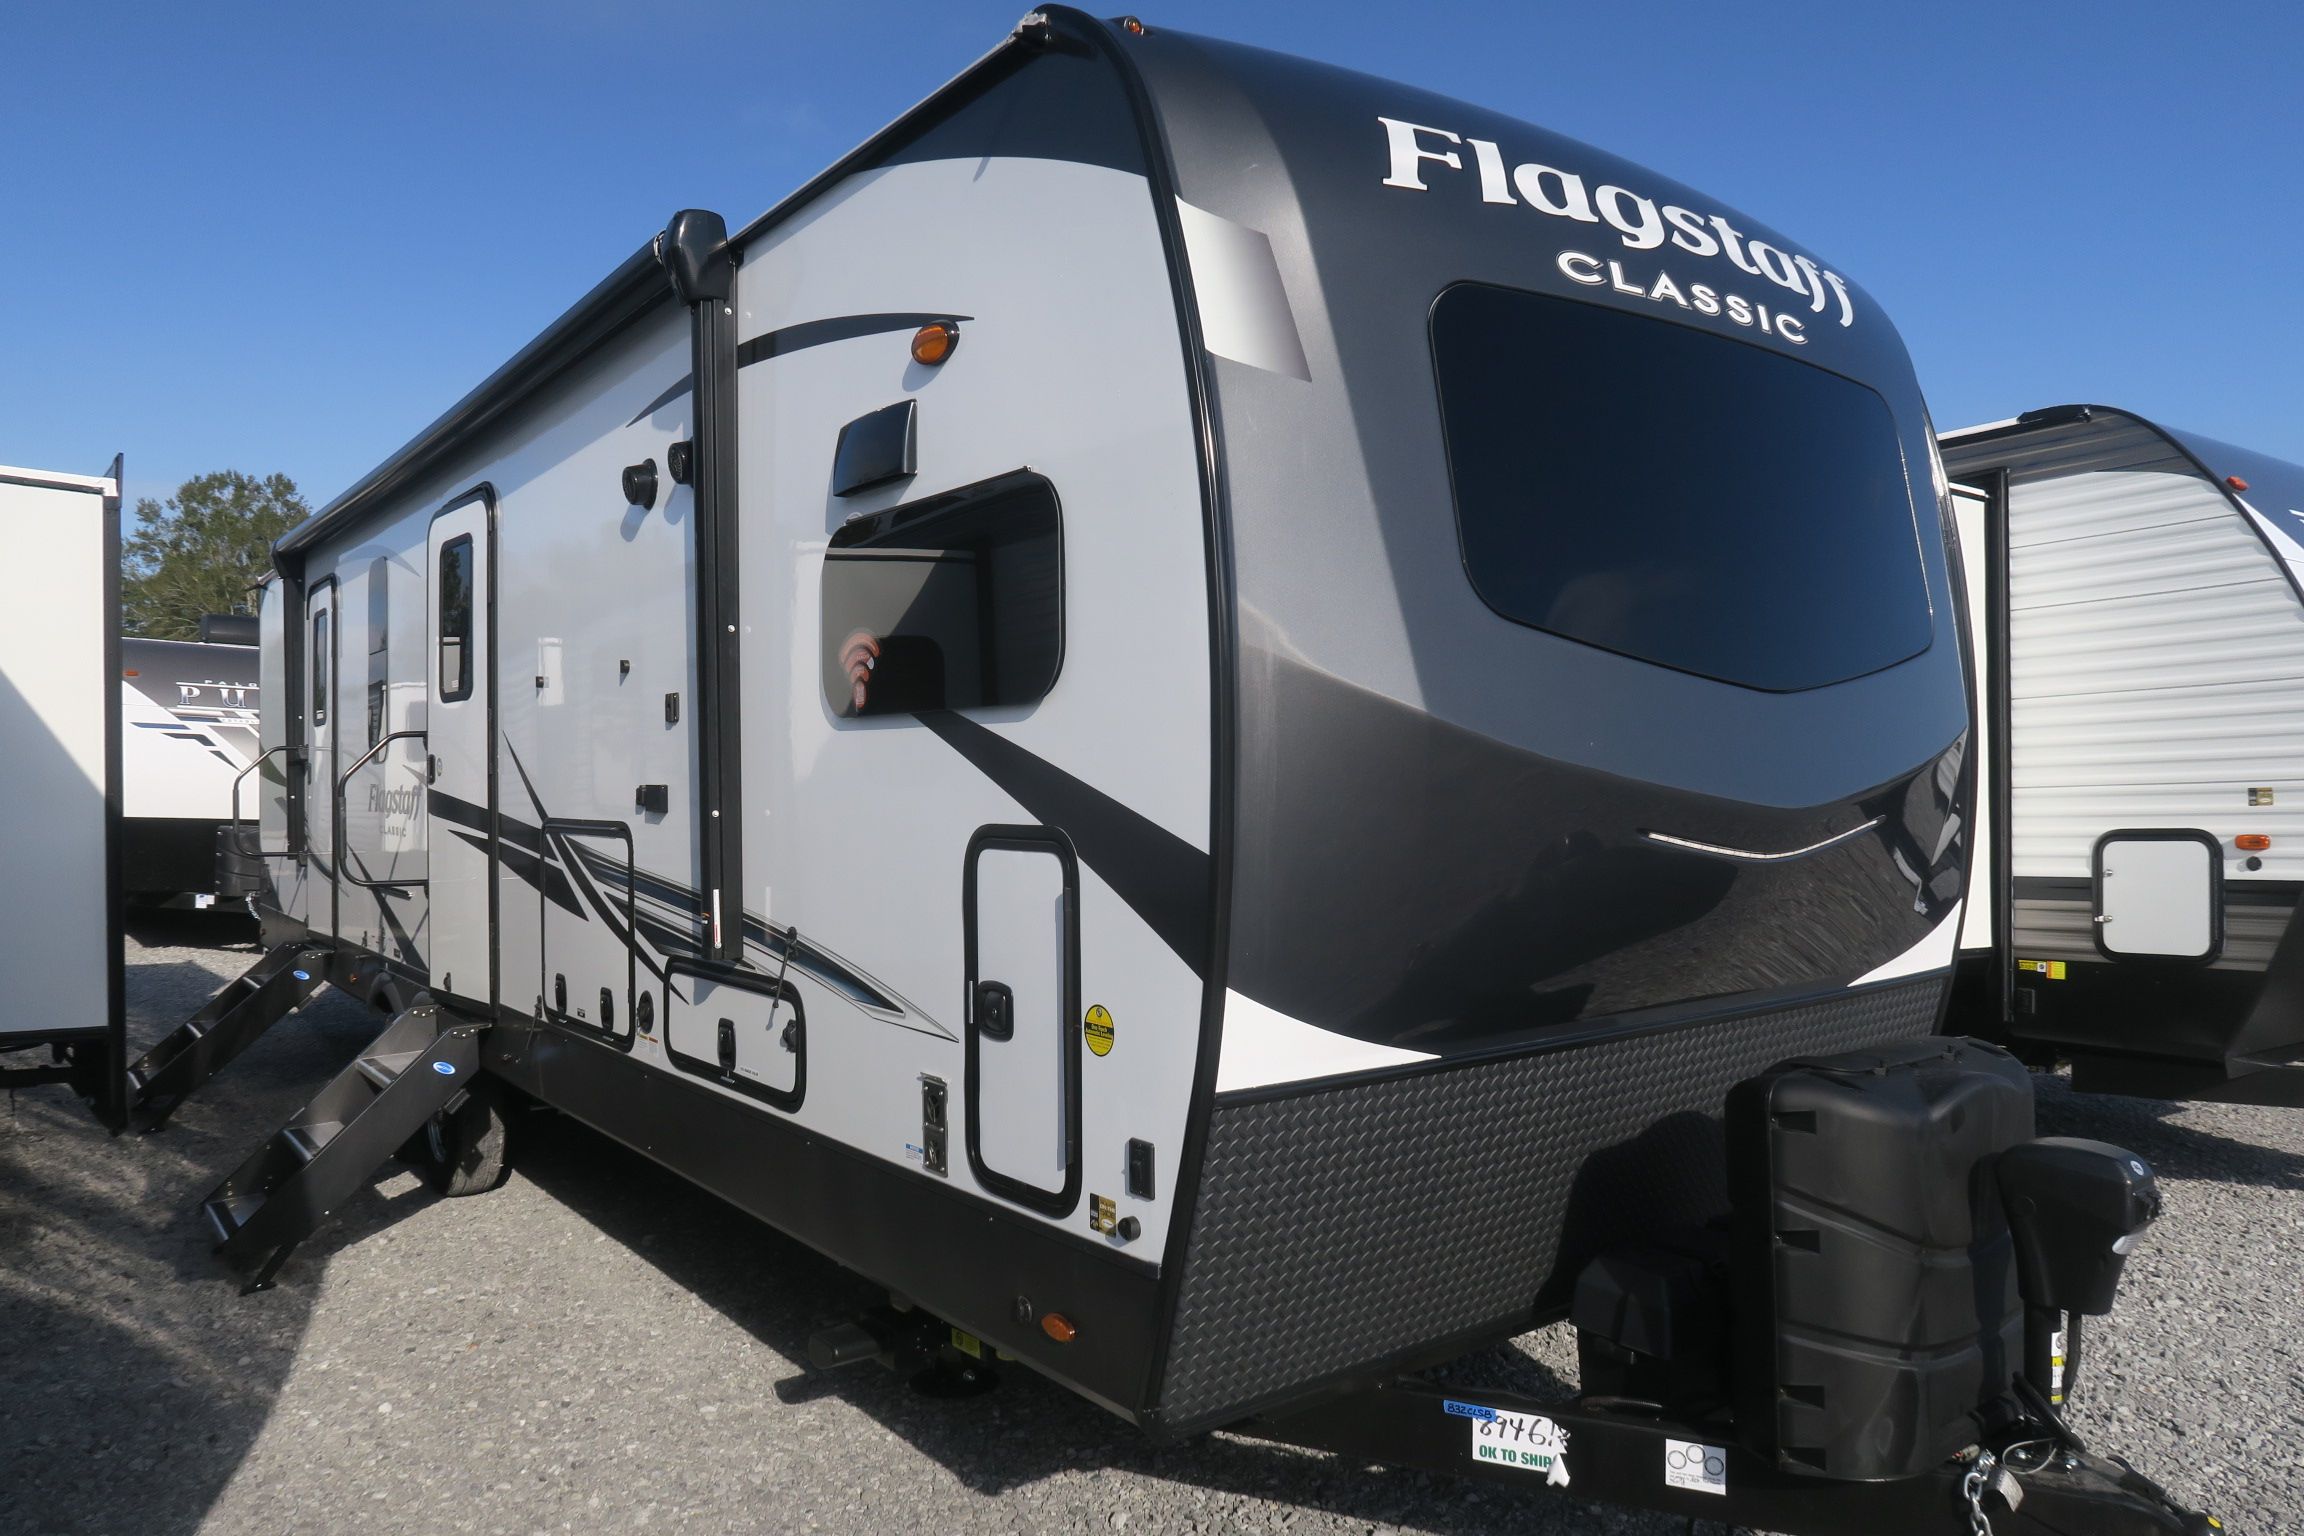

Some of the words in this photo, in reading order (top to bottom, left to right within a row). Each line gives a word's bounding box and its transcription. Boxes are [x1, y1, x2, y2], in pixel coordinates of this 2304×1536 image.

[1377, 116, 1855, 328] Flagstaff
[1556, 250, 1809, 345] CLASSIC
[368, 783, 423, 821] Flagstaff
[1479, 1444, 1498, 1459] OK
[1500, 1448, 1517, 1463] TO
[1520, 1451, 1553, 1468] SHIP
